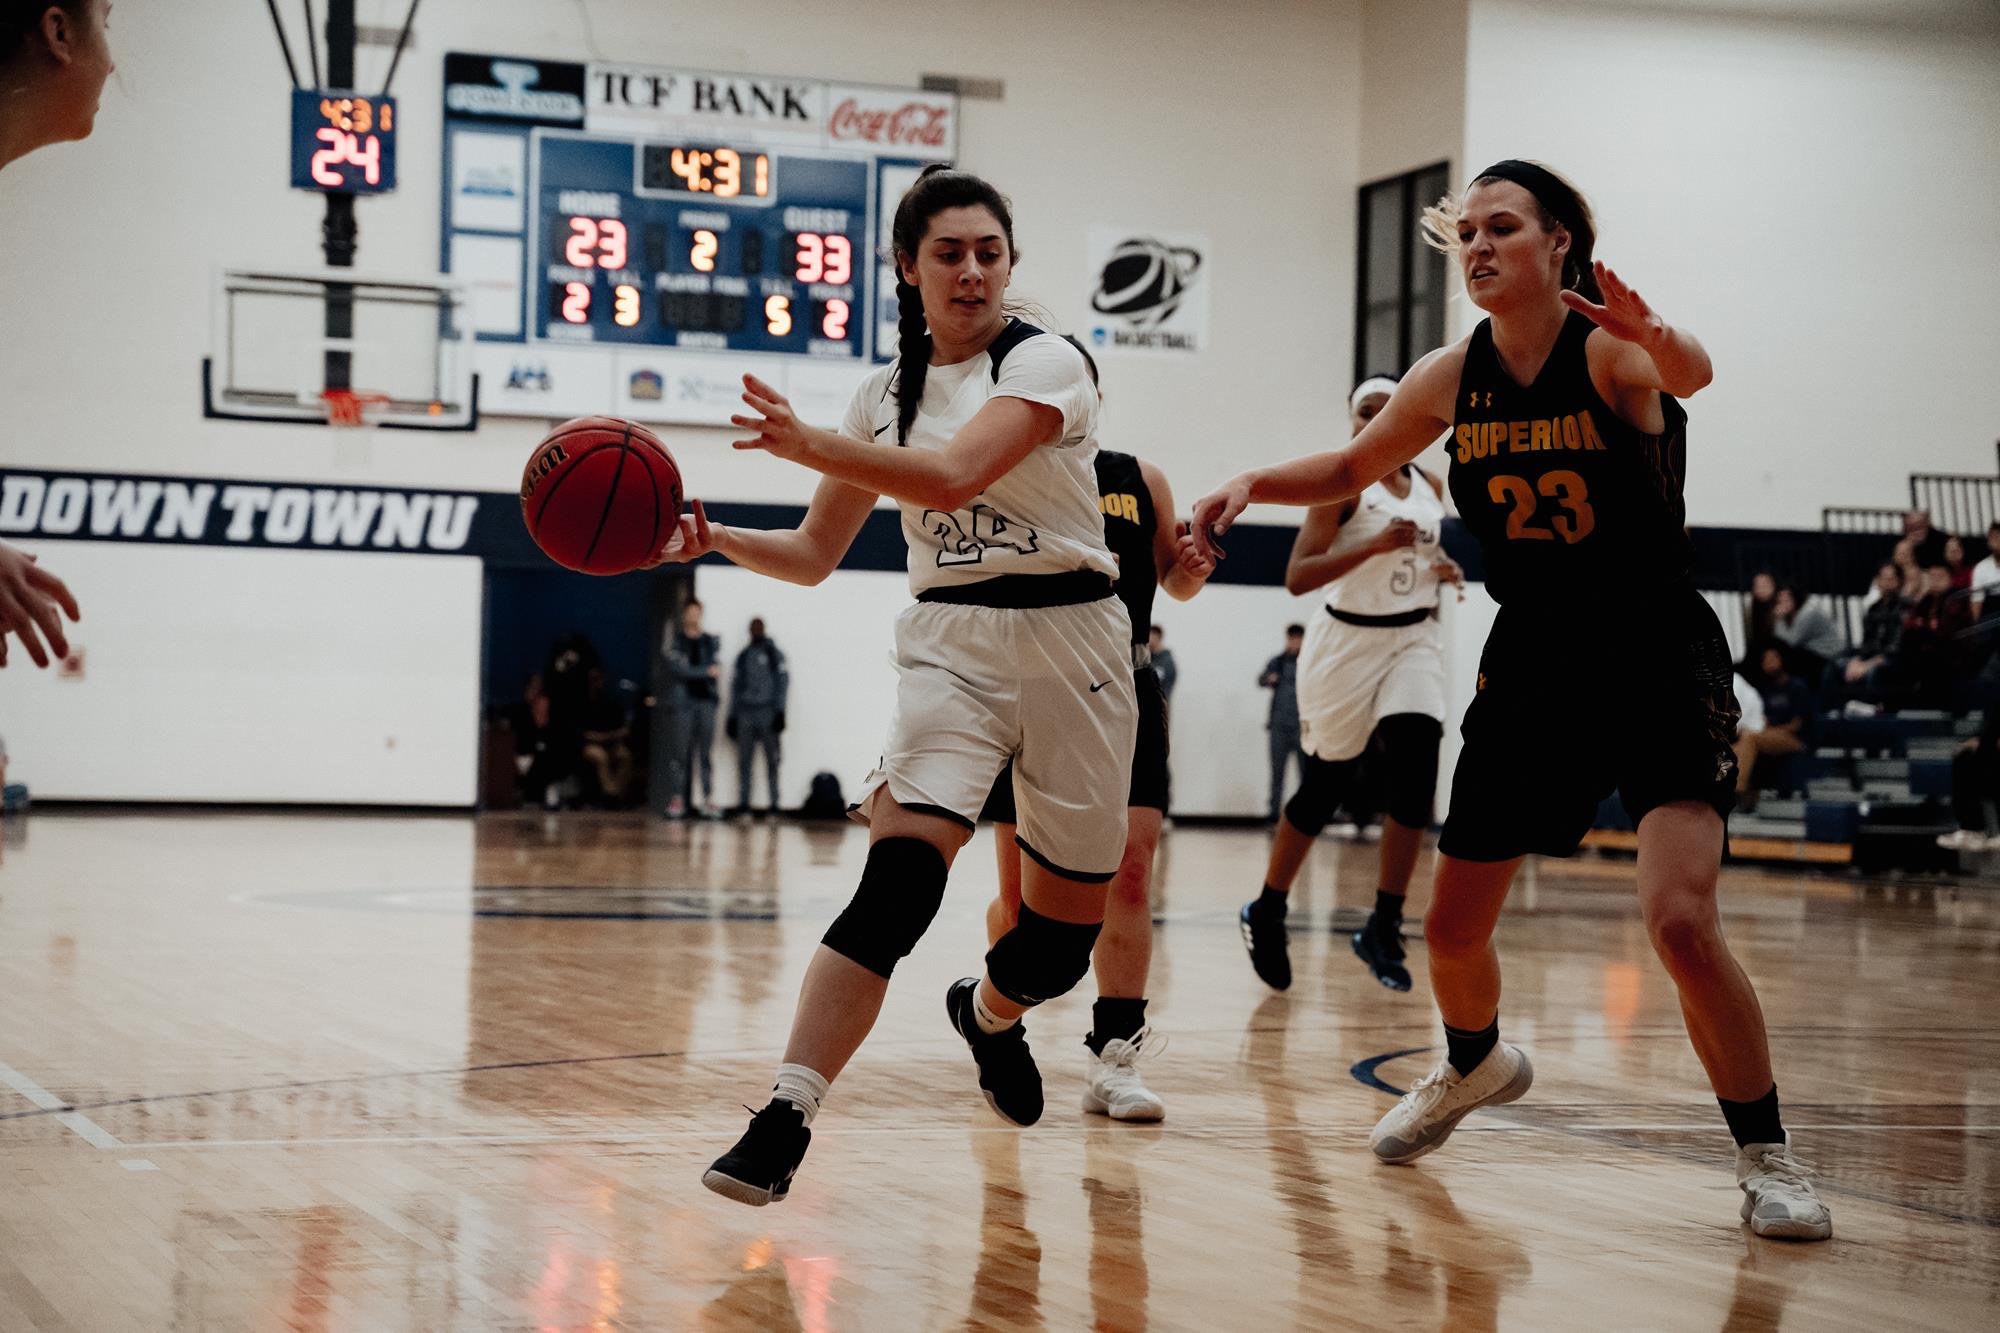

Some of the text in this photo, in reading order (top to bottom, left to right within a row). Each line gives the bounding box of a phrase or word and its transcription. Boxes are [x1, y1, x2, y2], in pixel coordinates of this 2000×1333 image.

[320, 98, 392, 133] 4:31
[595, 72, 677, 108] TCF
[693, 79, 811, 121] BANK
[311, 127, 380, 186] 24
[670, 147, 769, 198] 4:31
[565, 216, 627, 269] 23
[690, 230, 718, 272] 2
[795, 231, 851, 285] 33
[562, 281, 591, 325] 2
[614, 284, 640, 327] 3
[765, 294, 792, 337] 5
[822, 298, 849, 340] 2
[1455, 409, 1608, 465] SUPERIOR
[1487, 469, 1596, 545] 23
[921, 503, 1041, 569] 24
